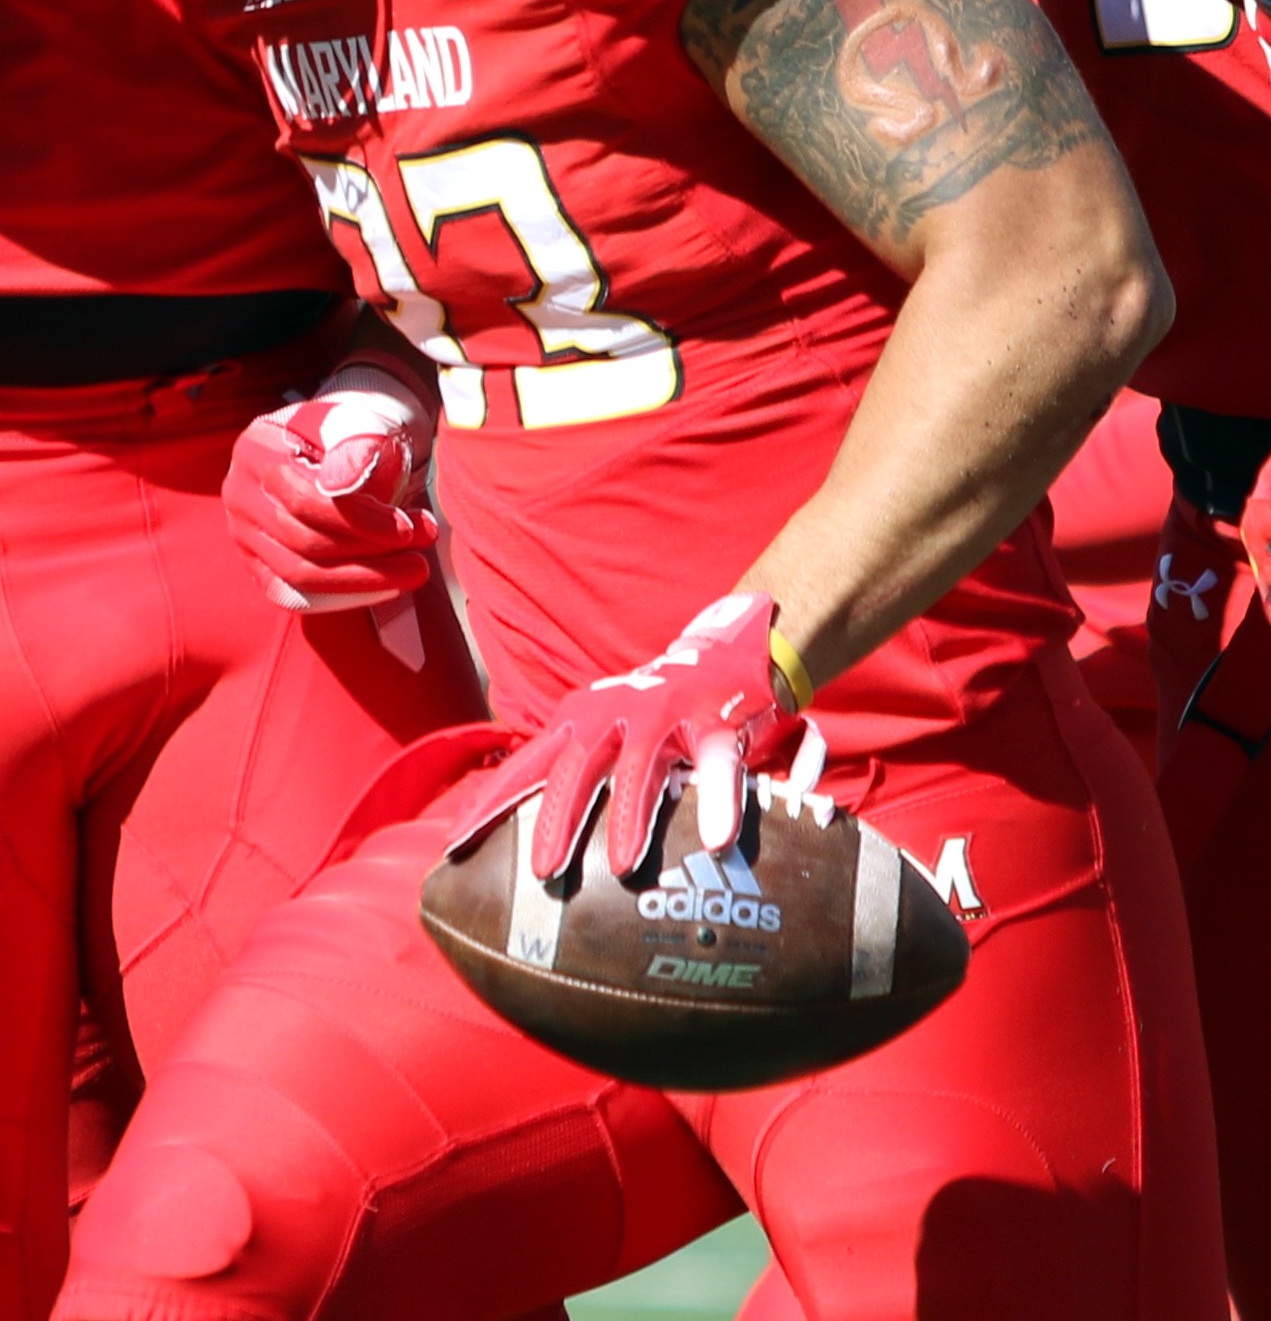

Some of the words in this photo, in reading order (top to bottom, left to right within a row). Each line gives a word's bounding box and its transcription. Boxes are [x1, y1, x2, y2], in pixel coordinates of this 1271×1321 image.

[266, 25, 472, 122] MARYLAND
[637, 886, 782, 934] adidas
[646, 954, 762, 988] DIME
